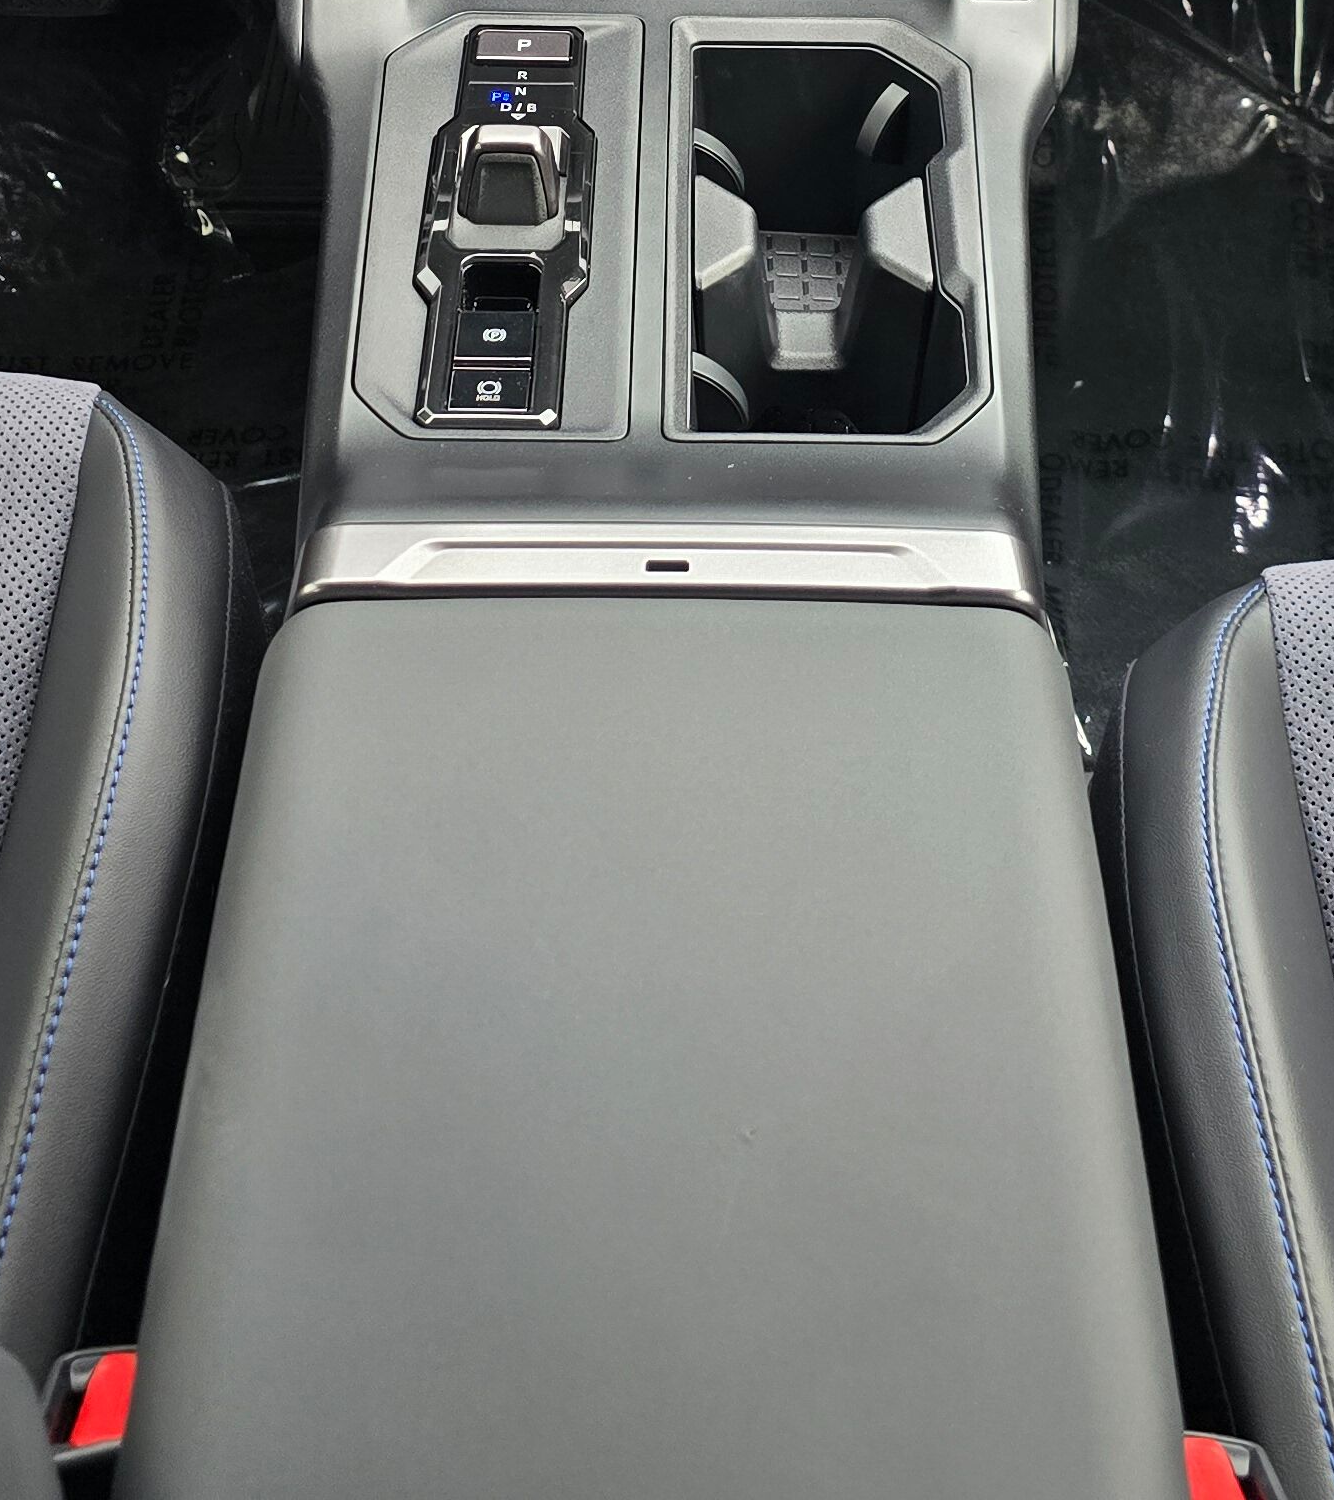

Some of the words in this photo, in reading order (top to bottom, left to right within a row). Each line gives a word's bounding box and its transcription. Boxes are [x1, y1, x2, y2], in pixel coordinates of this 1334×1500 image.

[517, 39, 532, 52] P
[517, 70, 528, 80] R
[514, 86, 527, 96] N
[475, 394, 501, 402] HOLD
